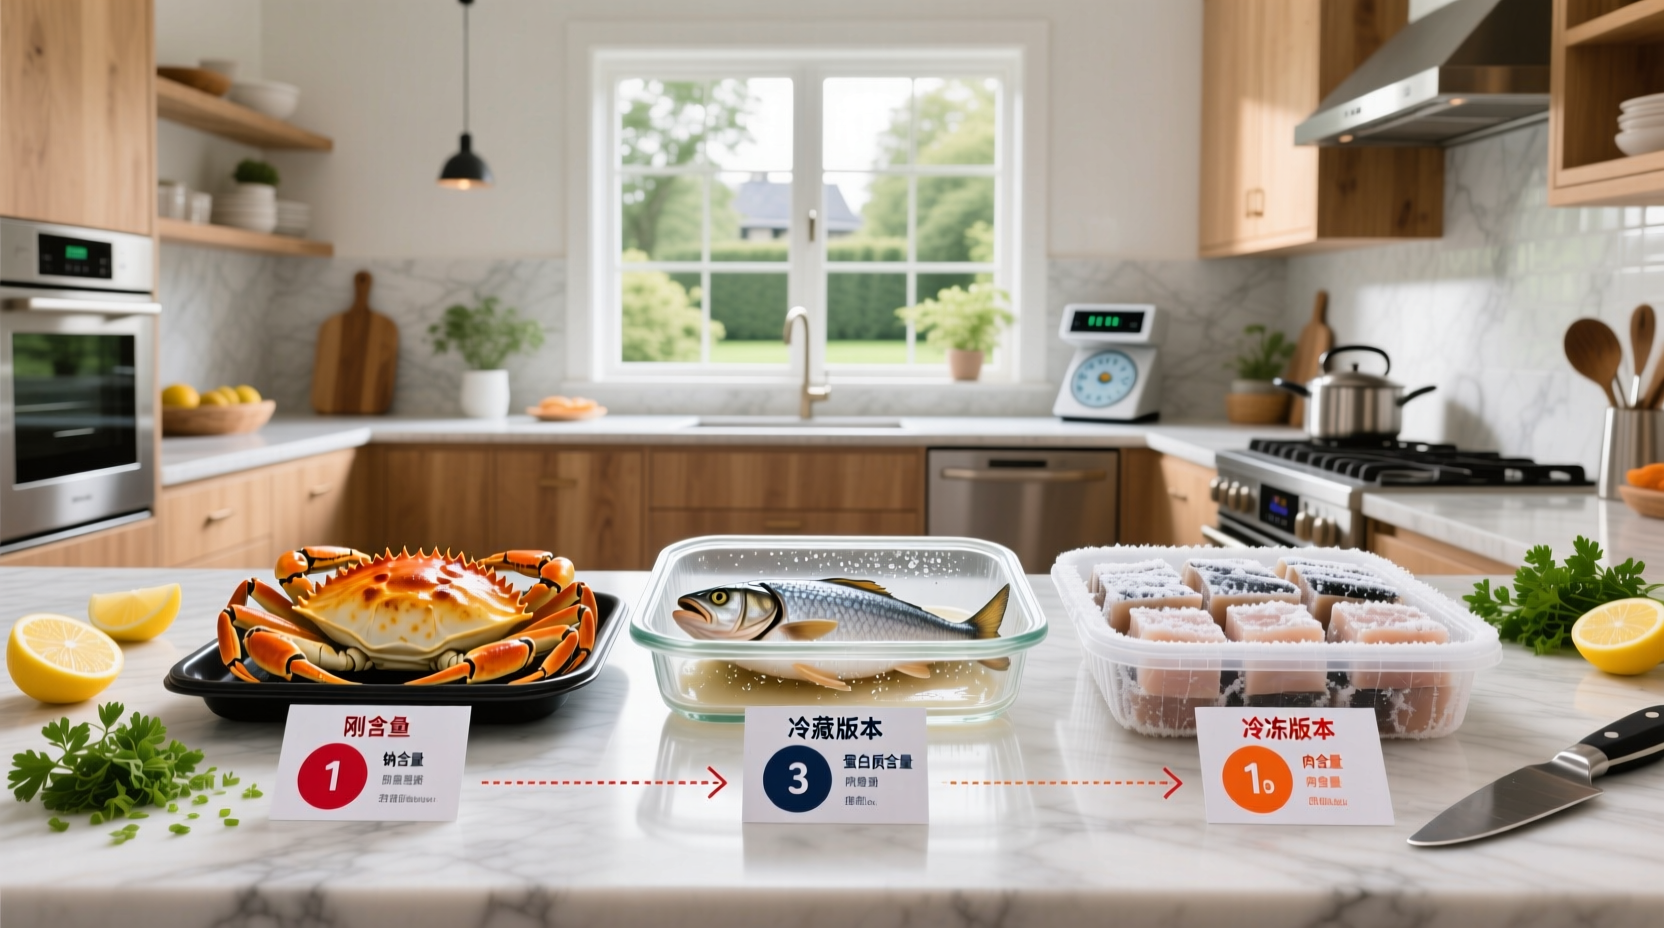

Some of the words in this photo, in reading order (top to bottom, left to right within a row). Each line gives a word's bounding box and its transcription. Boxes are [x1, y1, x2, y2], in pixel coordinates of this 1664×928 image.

[788, 715, 883, 741] 冷藏版本
[1242, 716, 1335, 740] 冷冻版本
[325, 760, 340, 791] 1
[788, 761, 809, 795] 3
